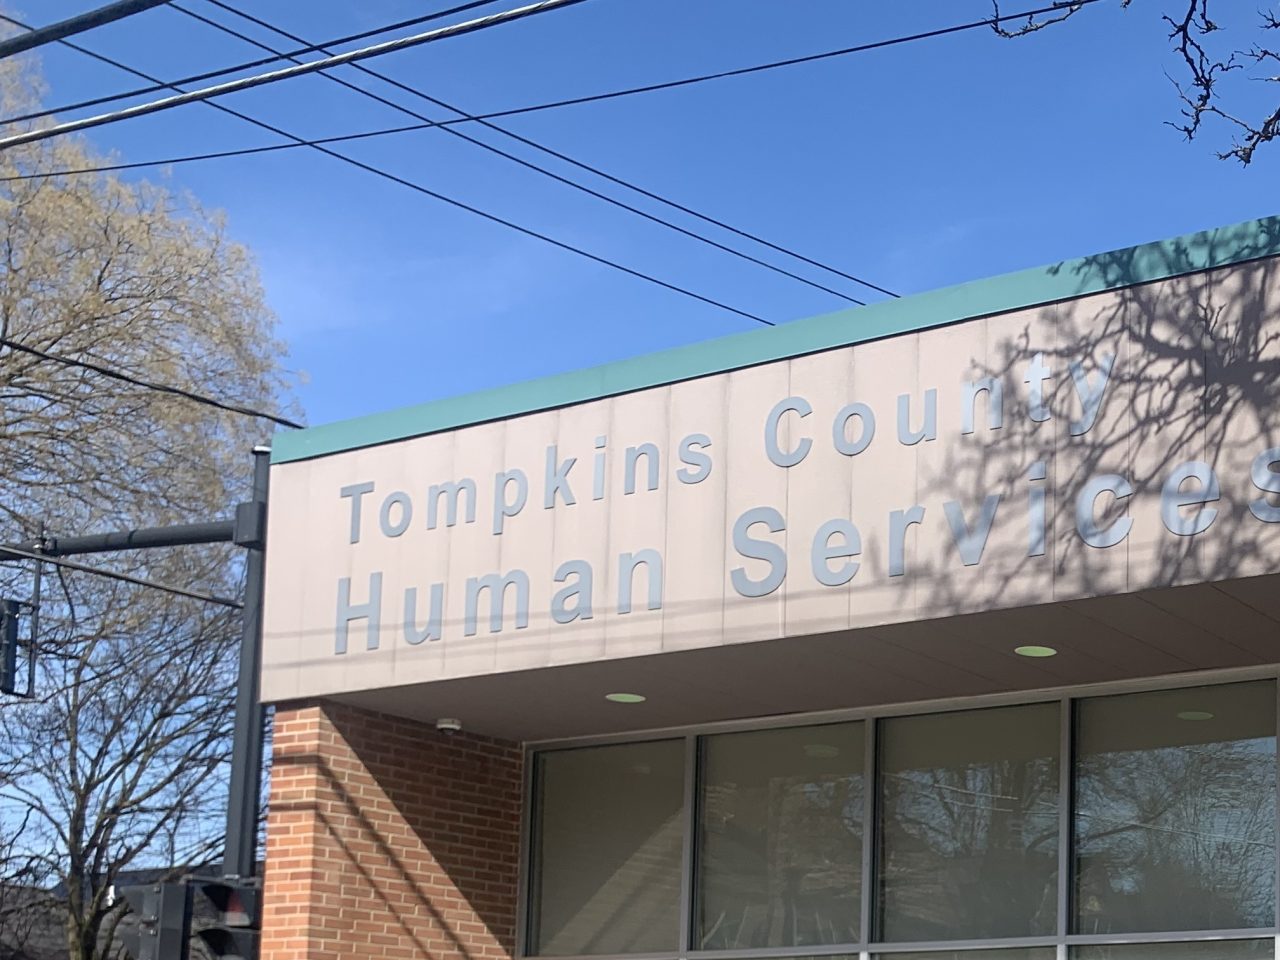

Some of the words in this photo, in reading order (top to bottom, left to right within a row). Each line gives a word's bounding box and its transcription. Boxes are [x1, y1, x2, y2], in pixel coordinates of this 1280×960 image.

[340, 432, 713, 545] Tompkins
[764, 352, 1117, 468] County
[334, 547, 663, 655] Human
